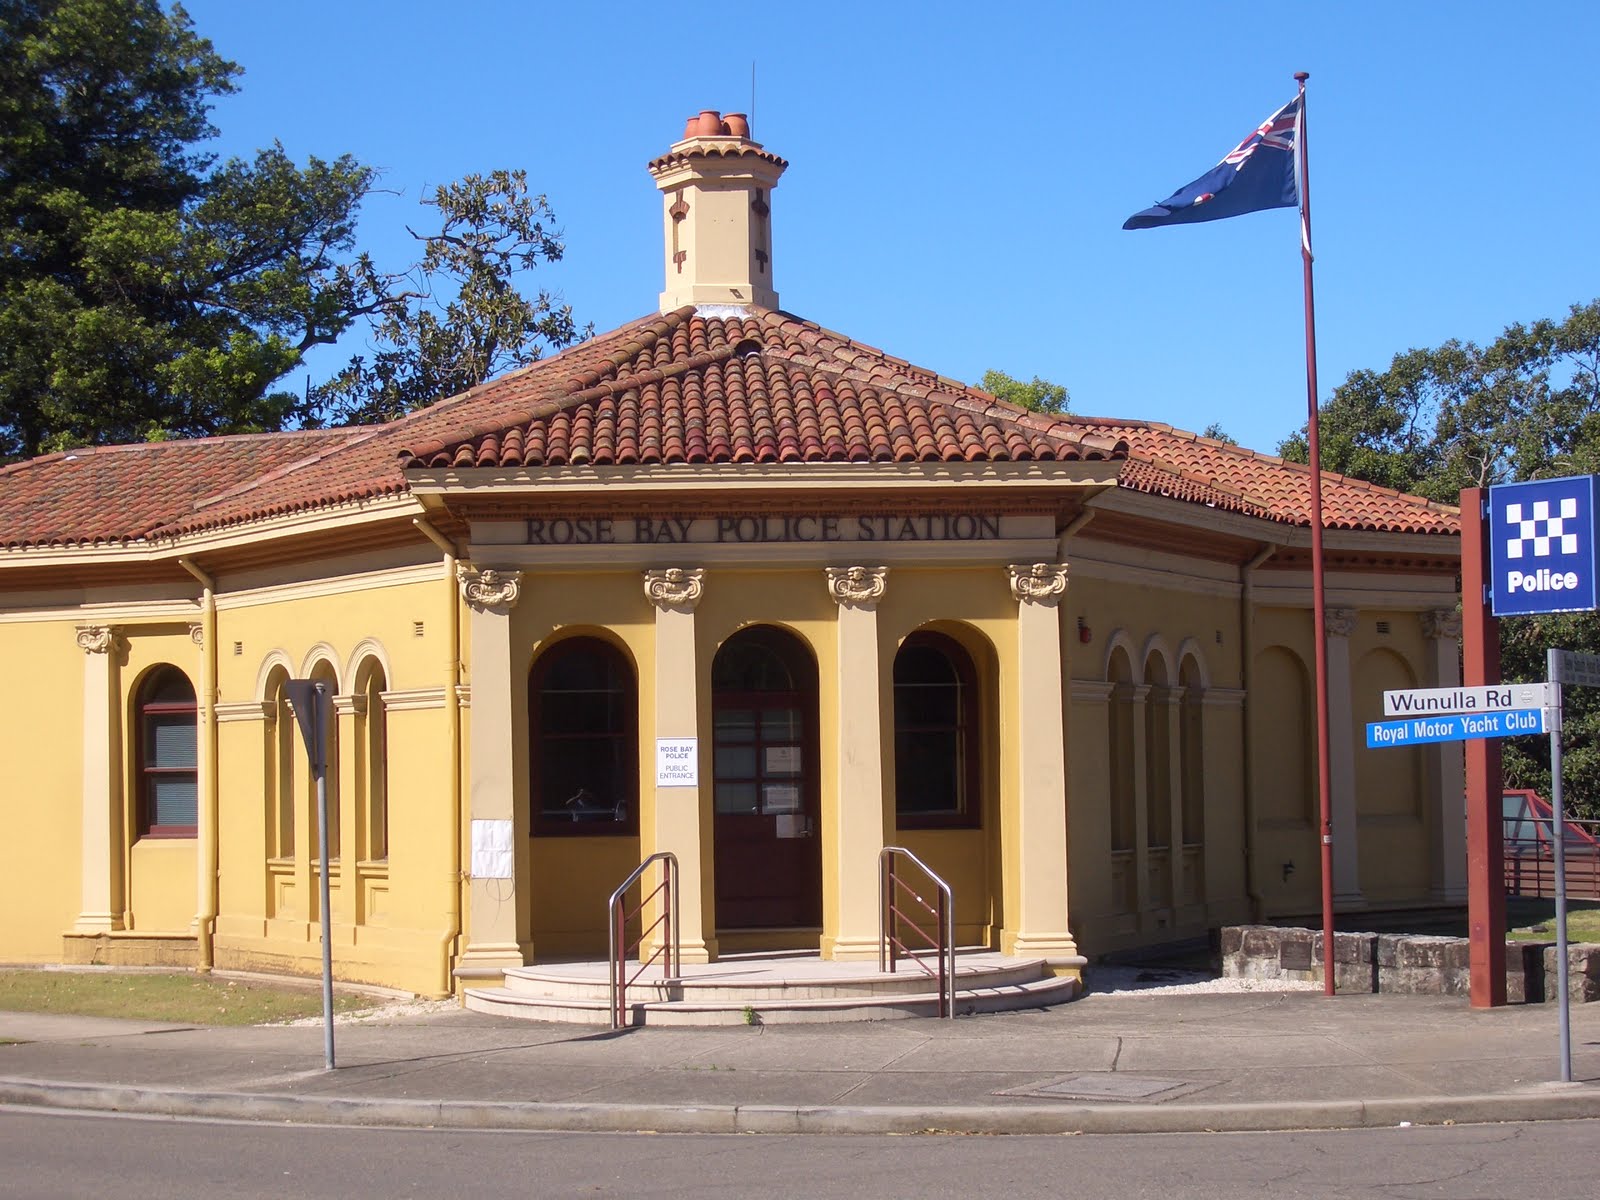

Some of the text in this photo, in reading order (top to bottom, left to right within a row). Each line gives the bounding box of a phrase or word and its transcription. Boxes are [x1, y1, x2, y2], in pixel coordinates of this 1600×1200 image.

[525, 513, 1002, 544] ROSE BAY POLICE STATION
[1507, 569, 1578, 593] Police
[1390, 689, 1512, 711] Wunulla Rd
[1374, 712, 1537, 744] Royal Motor Yacht Club
